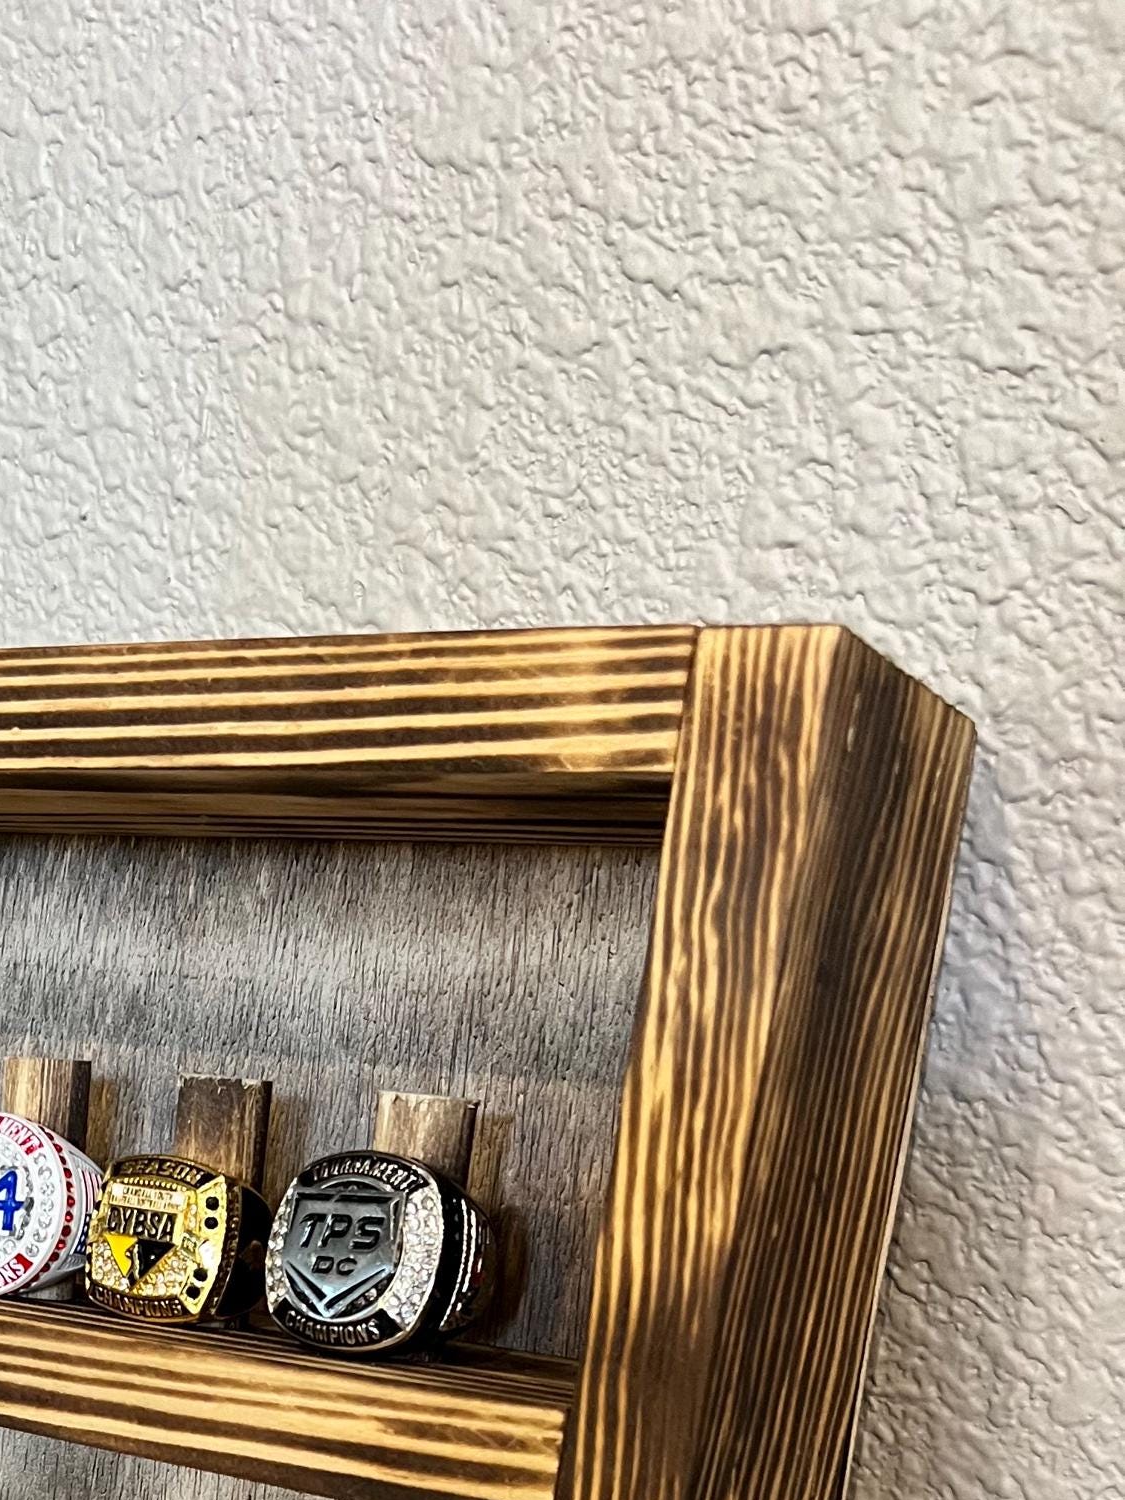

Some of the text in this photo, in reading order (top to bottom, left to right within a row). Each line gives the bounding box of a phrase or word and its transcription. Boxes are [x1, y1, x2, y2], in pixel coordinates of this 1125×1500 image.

[121, 1160, 204, 1187] SEASON
[313, 1157, 425, 1195] TOURNAMENT
[299, 1212, 386, 1251] TPS
[311, 1254, 358, 1276] DC
[94, 1285, 183, 1318] CHAMPIONS
[284, 1309, 380, 1346] CHAMPIONS
